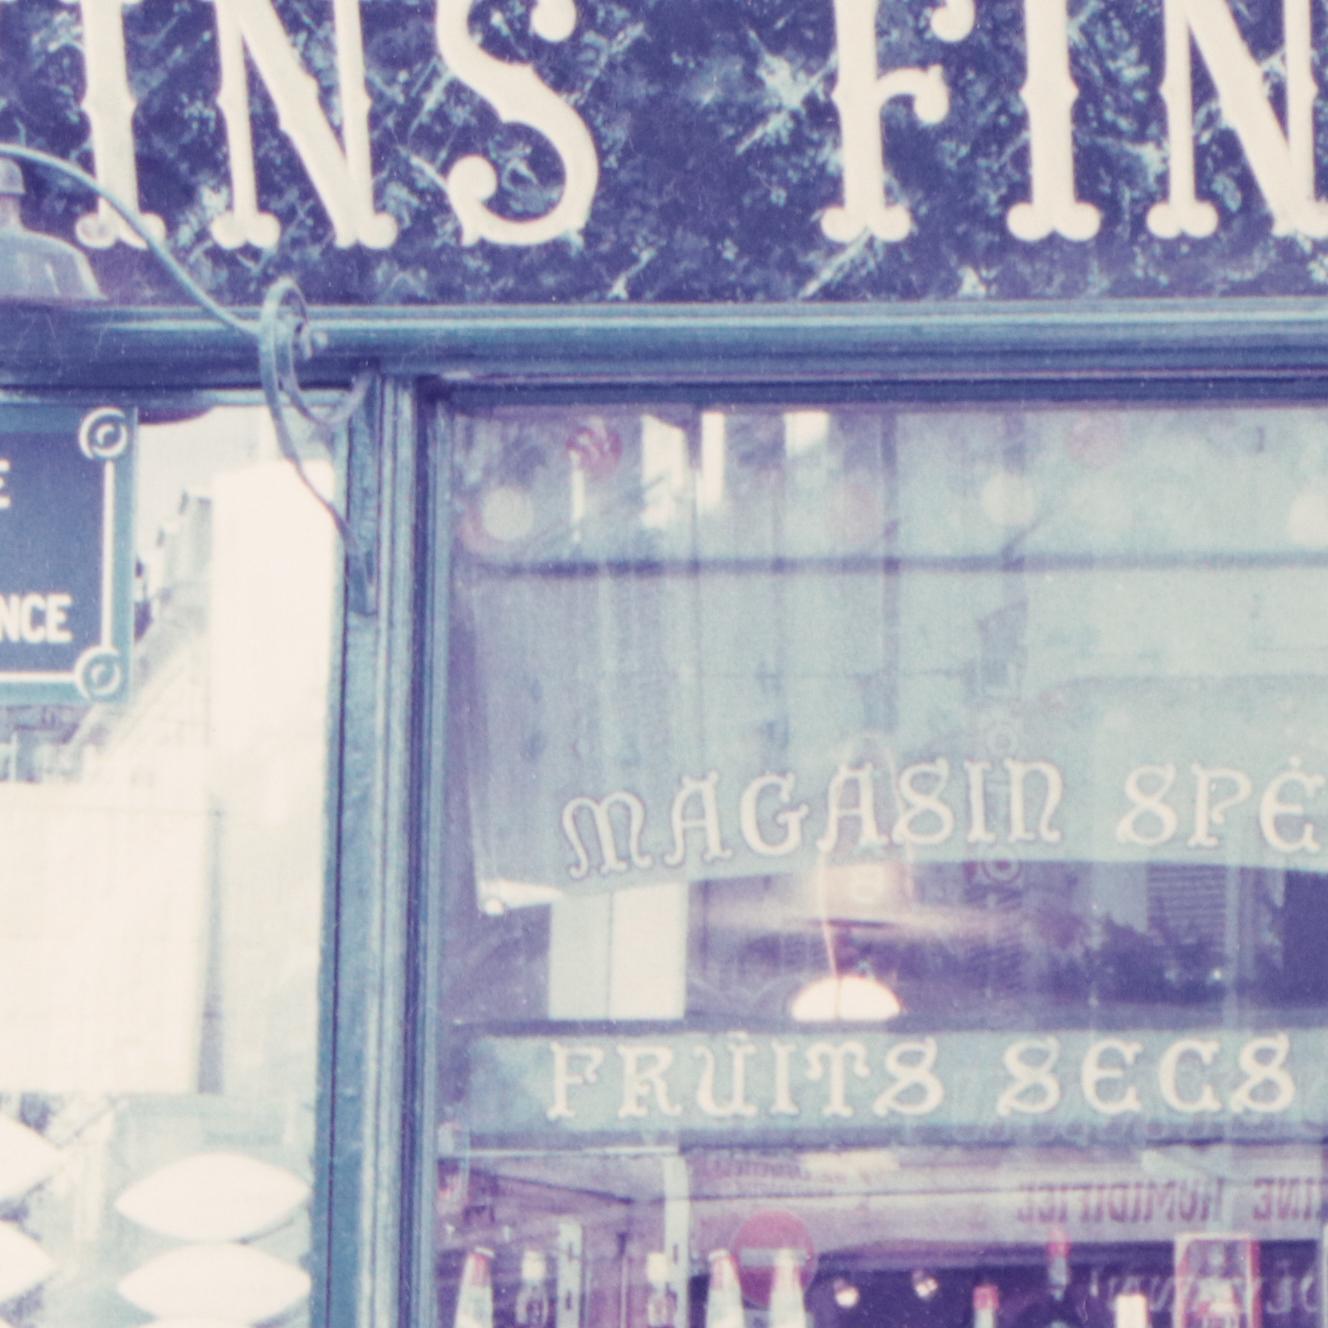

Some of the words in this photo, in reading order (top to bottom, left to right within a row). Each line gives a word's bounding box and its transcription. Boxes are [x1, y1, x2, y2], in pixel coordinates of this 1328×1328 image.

[560, 757, 1064, 879] MAGASIN
[546, 1035, 945, 1121] FRUITS
[997, 1032, 1296, 1118] SECS
